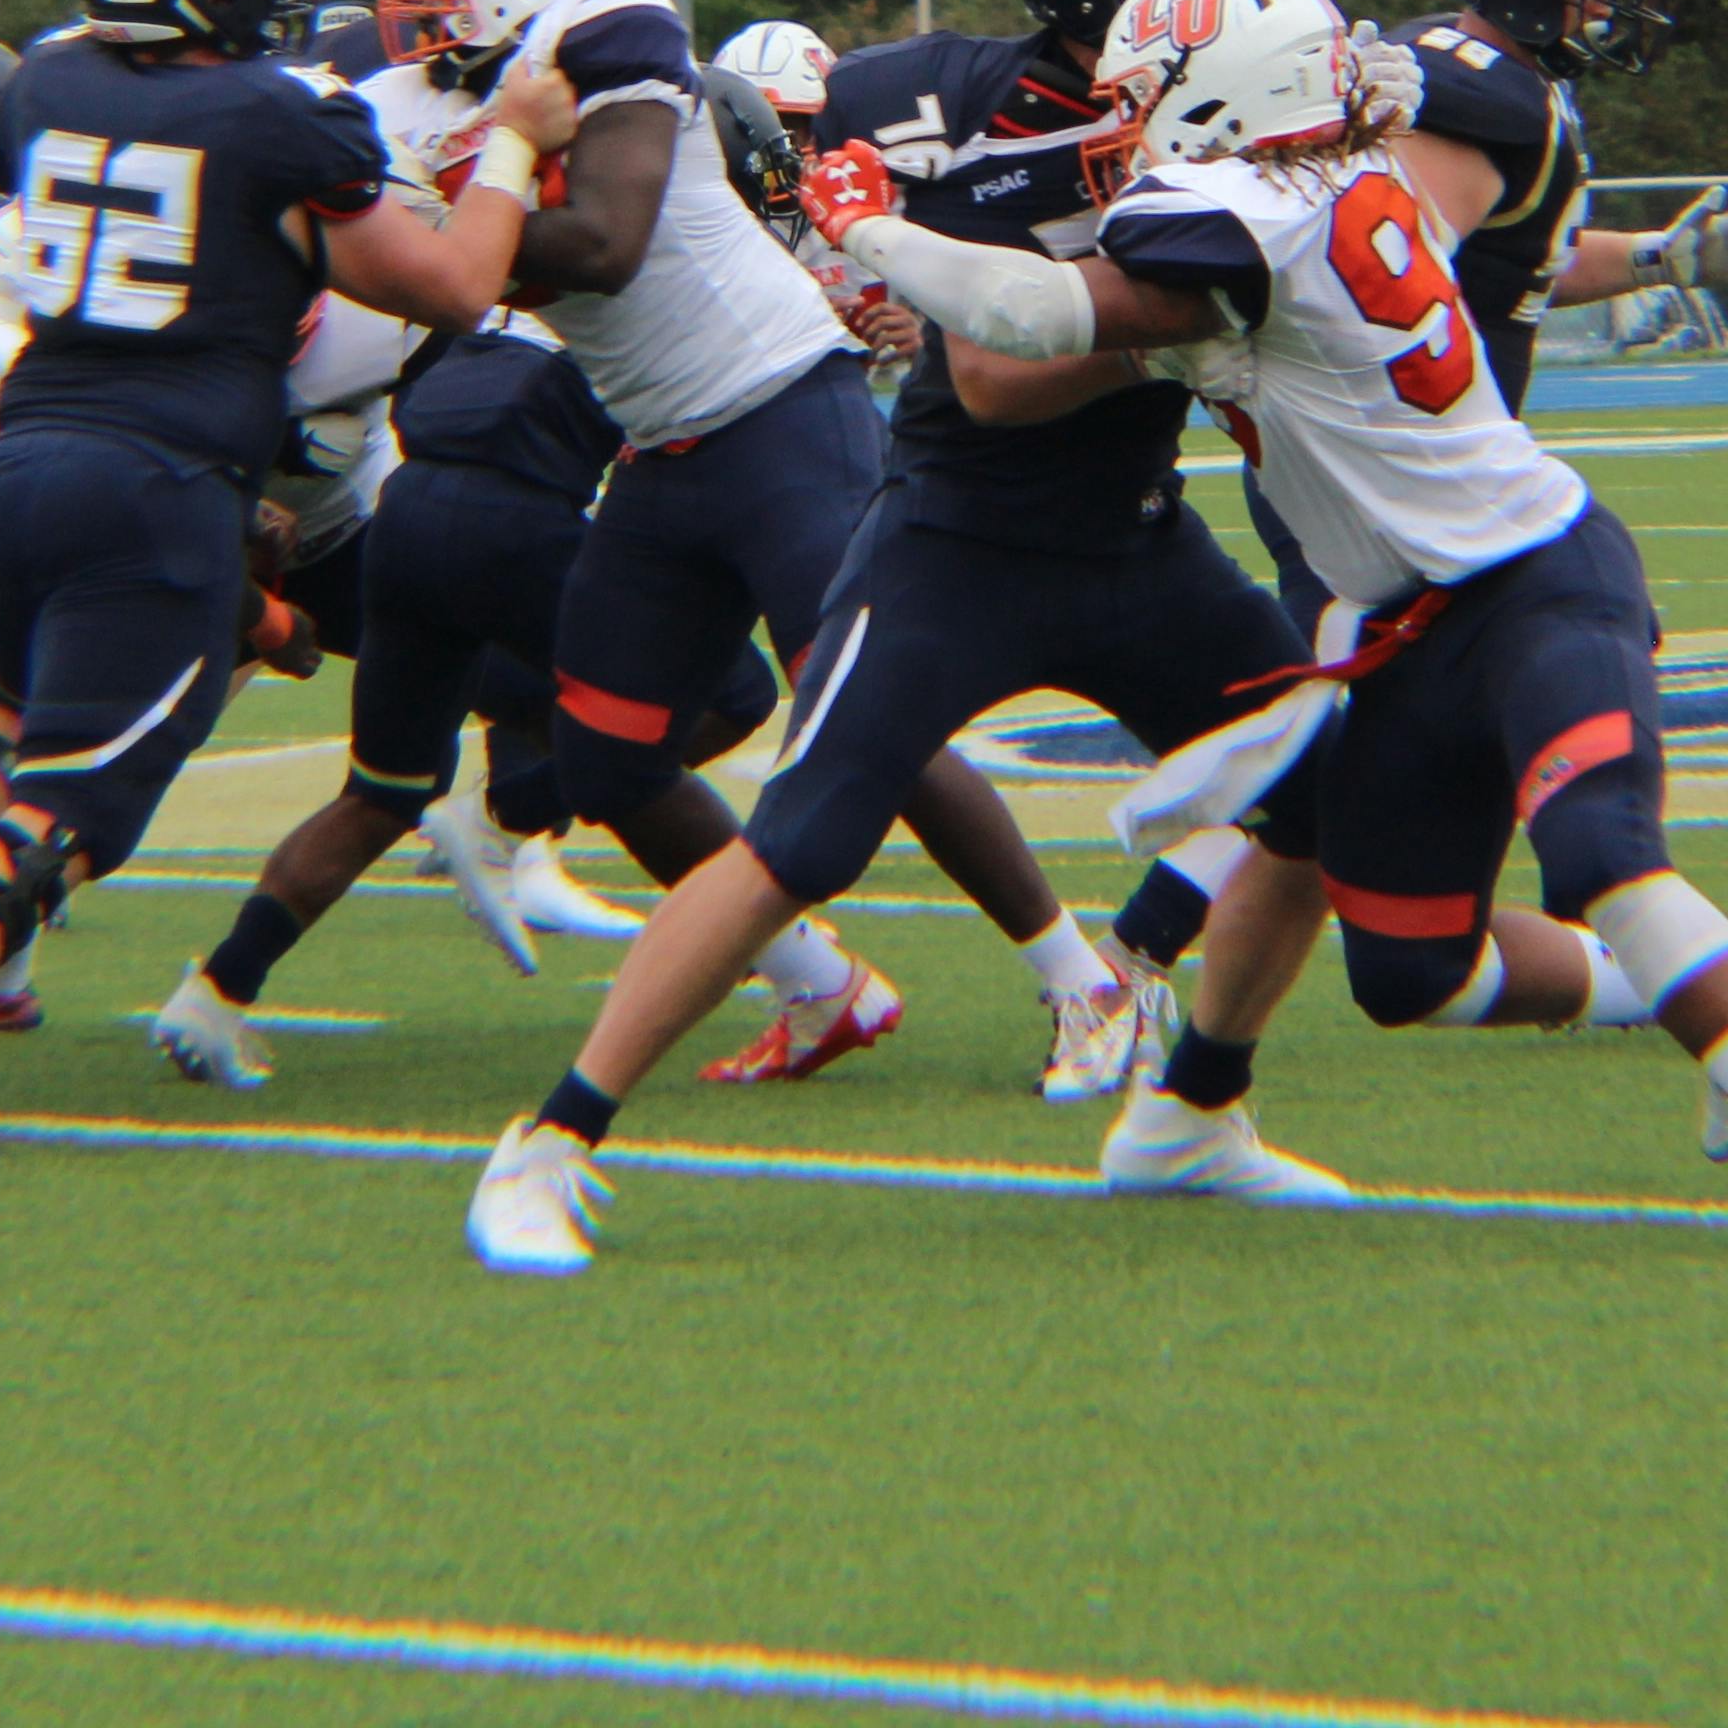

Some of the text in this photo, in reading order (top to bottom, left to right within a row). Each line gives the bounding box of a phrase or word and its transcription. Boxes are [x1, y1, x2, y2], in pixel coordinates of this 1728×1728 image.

[24, 129, 206, 330] 62
[972, 169, 1030, 203] PSAC
[1327, 171, 1475, 412] 9
